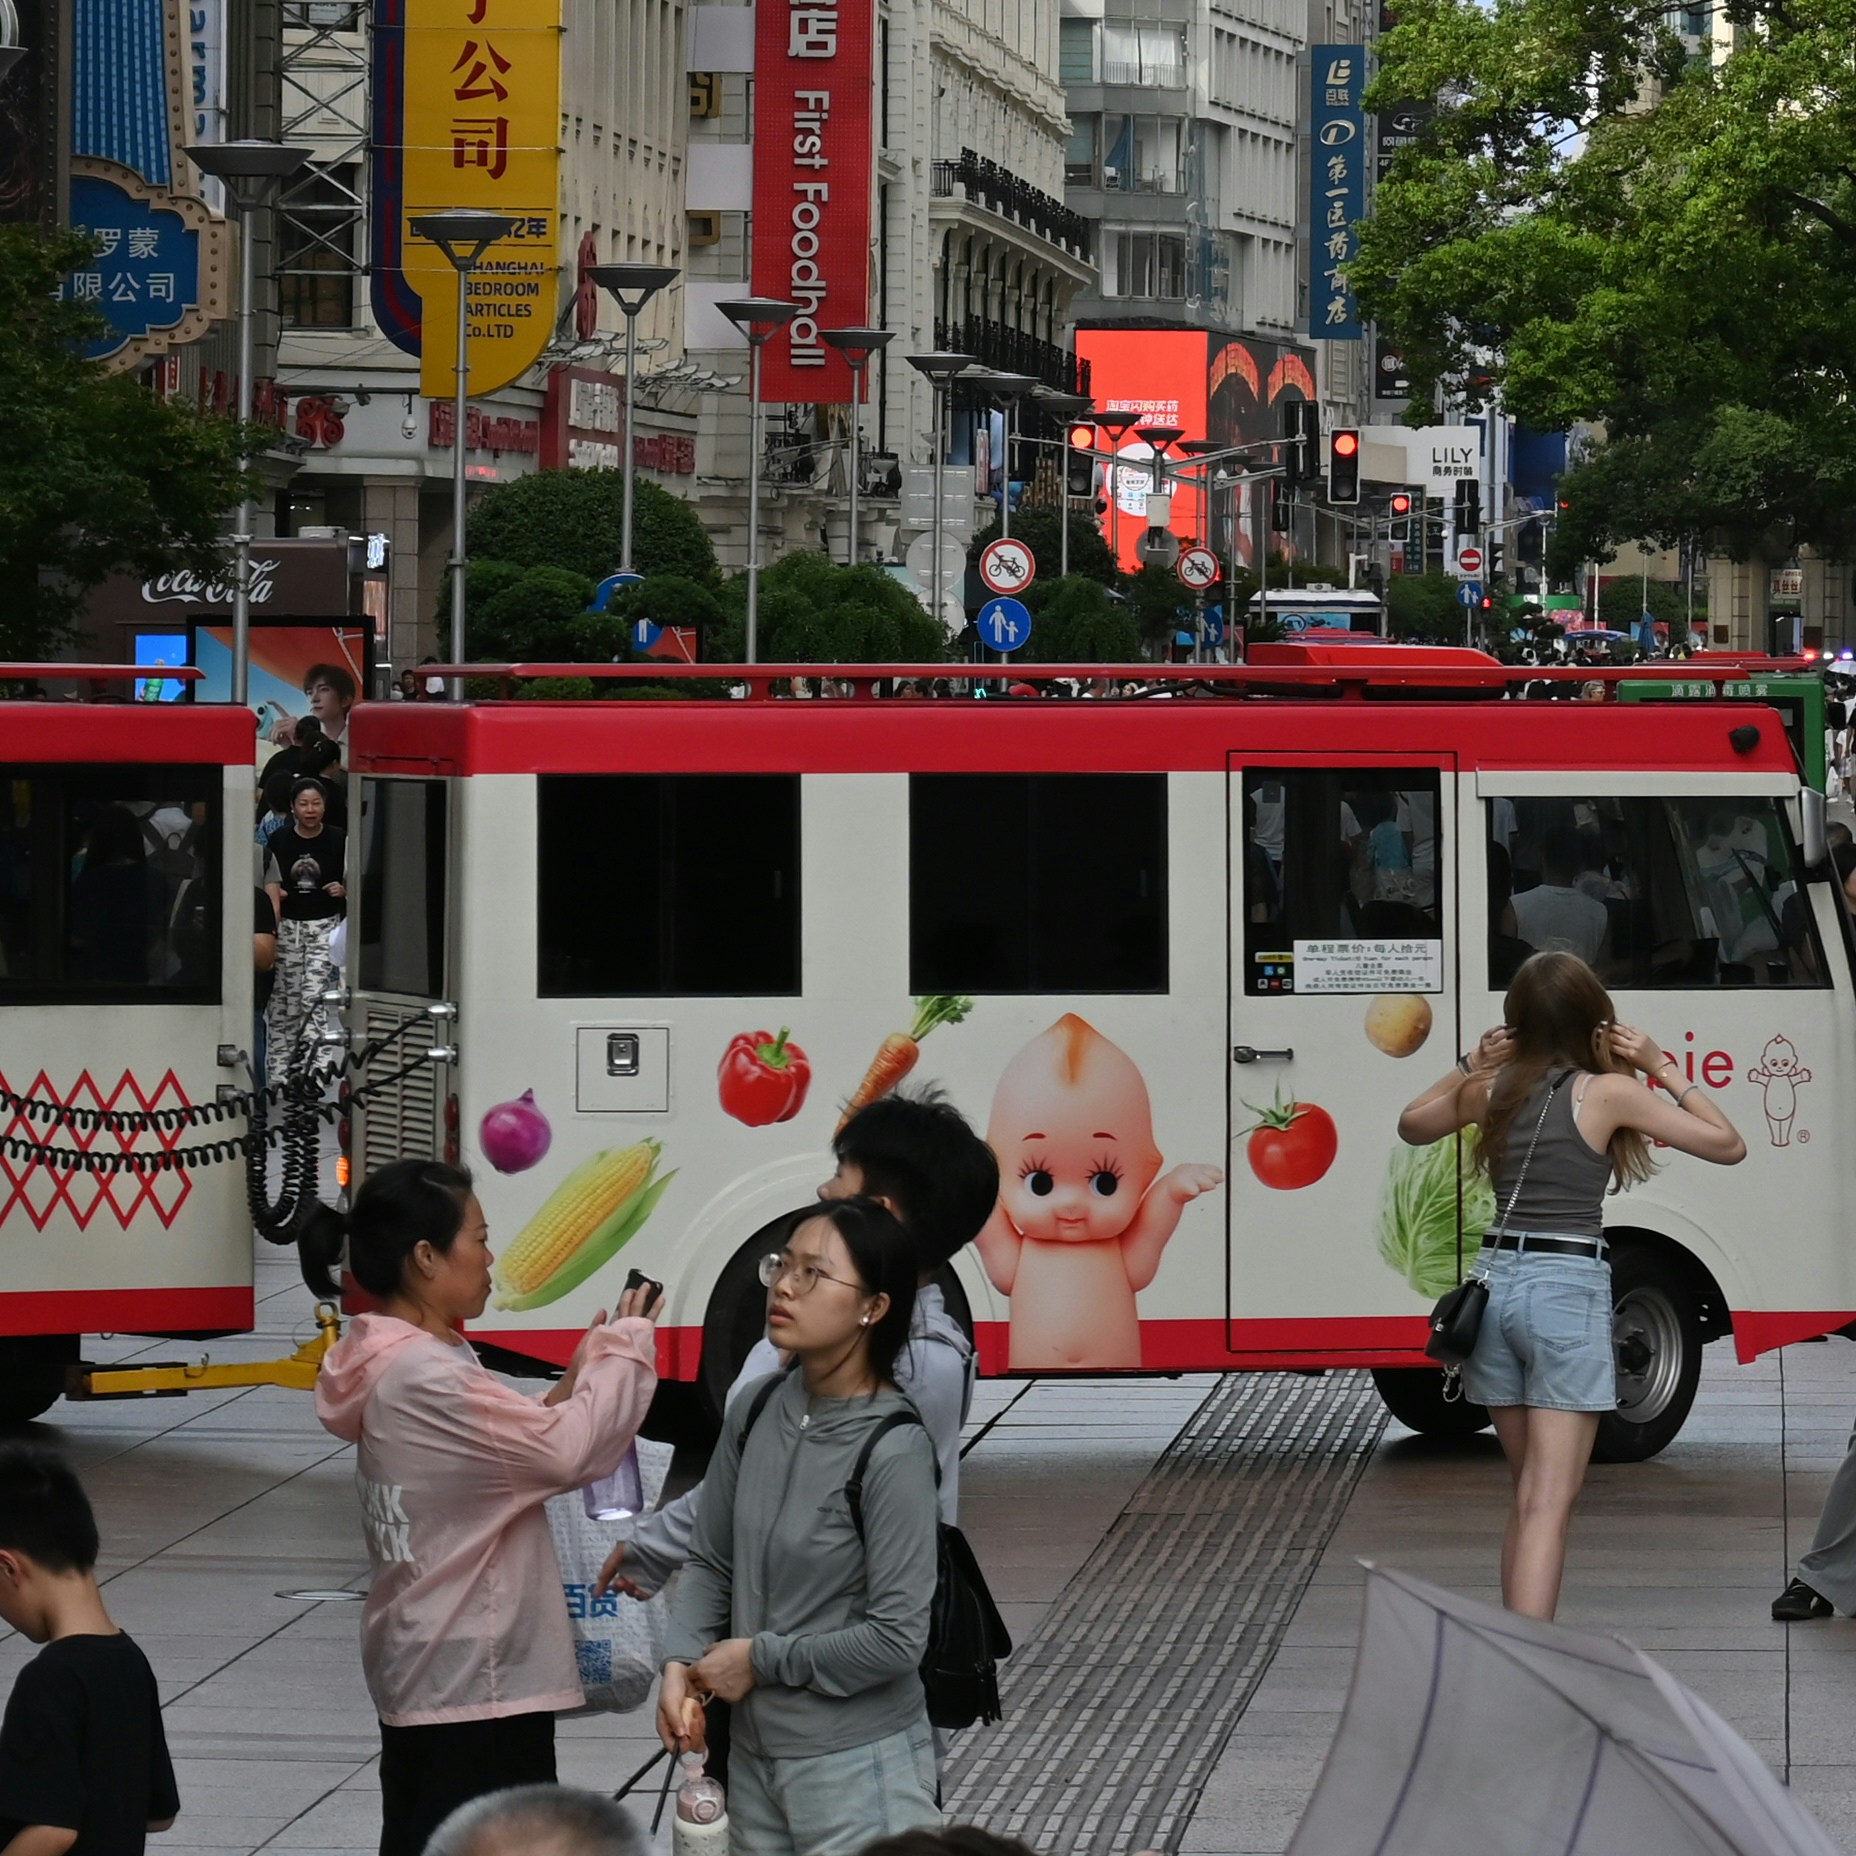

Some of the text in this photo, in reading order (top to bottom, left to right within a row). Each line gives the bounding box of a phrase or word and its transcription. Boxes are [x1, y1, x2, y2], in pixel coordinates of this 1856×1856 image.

[1325, 88, 1350, 101] 百联
[789, 89, 831, 368] First Foodhall
[84, 227, 160, 260] 罗蒙
[466, 303, 532, 318] ARTICLES
[1134, 414, 1179, 427] 钟送达
[1432, 447, 1473, 464] LILY
[562, 1583, 619, 1619] 百货
